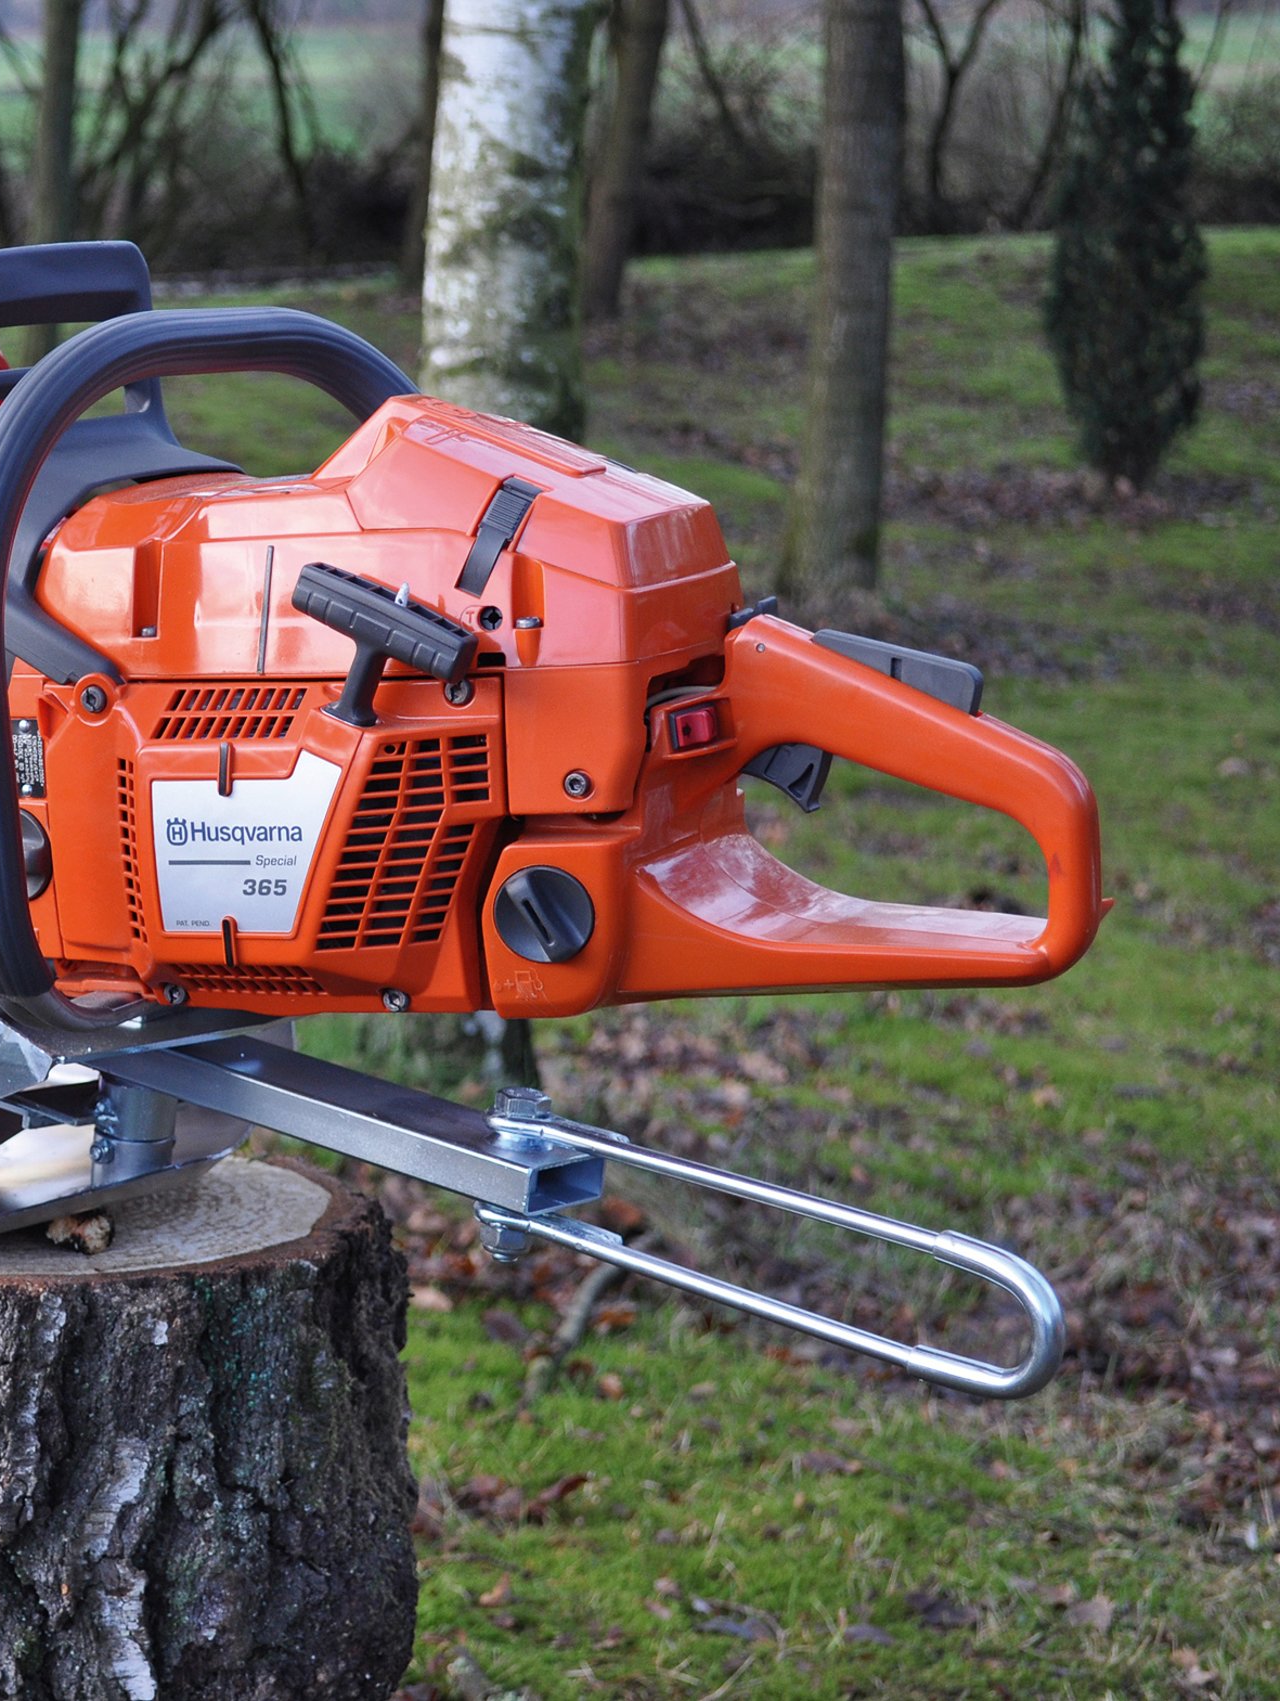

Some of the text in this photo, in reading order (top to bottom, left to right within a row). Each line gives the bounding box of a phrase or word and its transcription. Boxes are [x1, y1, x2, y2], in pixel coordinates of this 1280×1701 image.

[190, 821, 303, 846] Husqvarna
[255, 854, 297, 868] Special
[242, 878, 288, 896] 365
